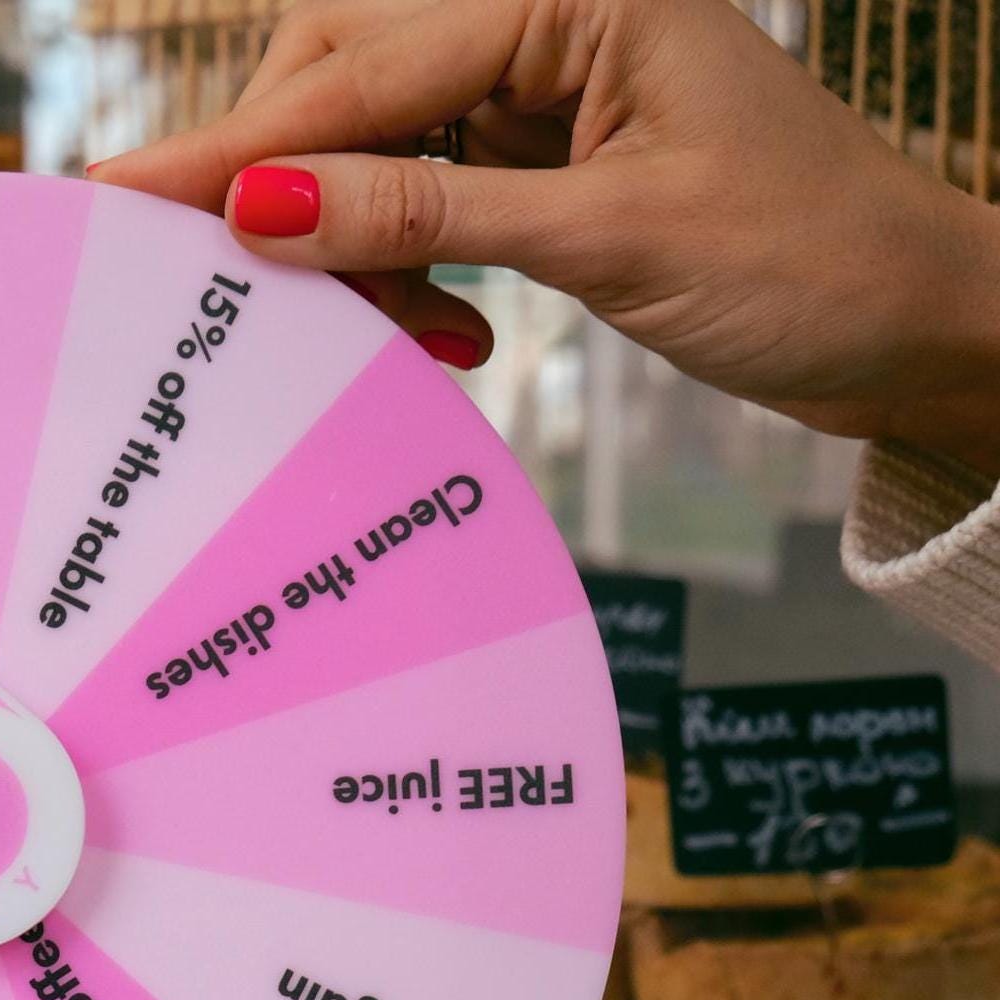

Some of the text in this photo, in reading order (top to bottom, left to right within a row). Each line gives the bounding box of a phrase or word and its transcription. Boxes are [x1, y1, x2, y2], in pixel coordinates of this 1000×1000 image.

[40, 274, 251, 628] 15% off the table
[147, 475, 482, 699] Clean the dishes
[333, 759, 573, 814] FREE juice
